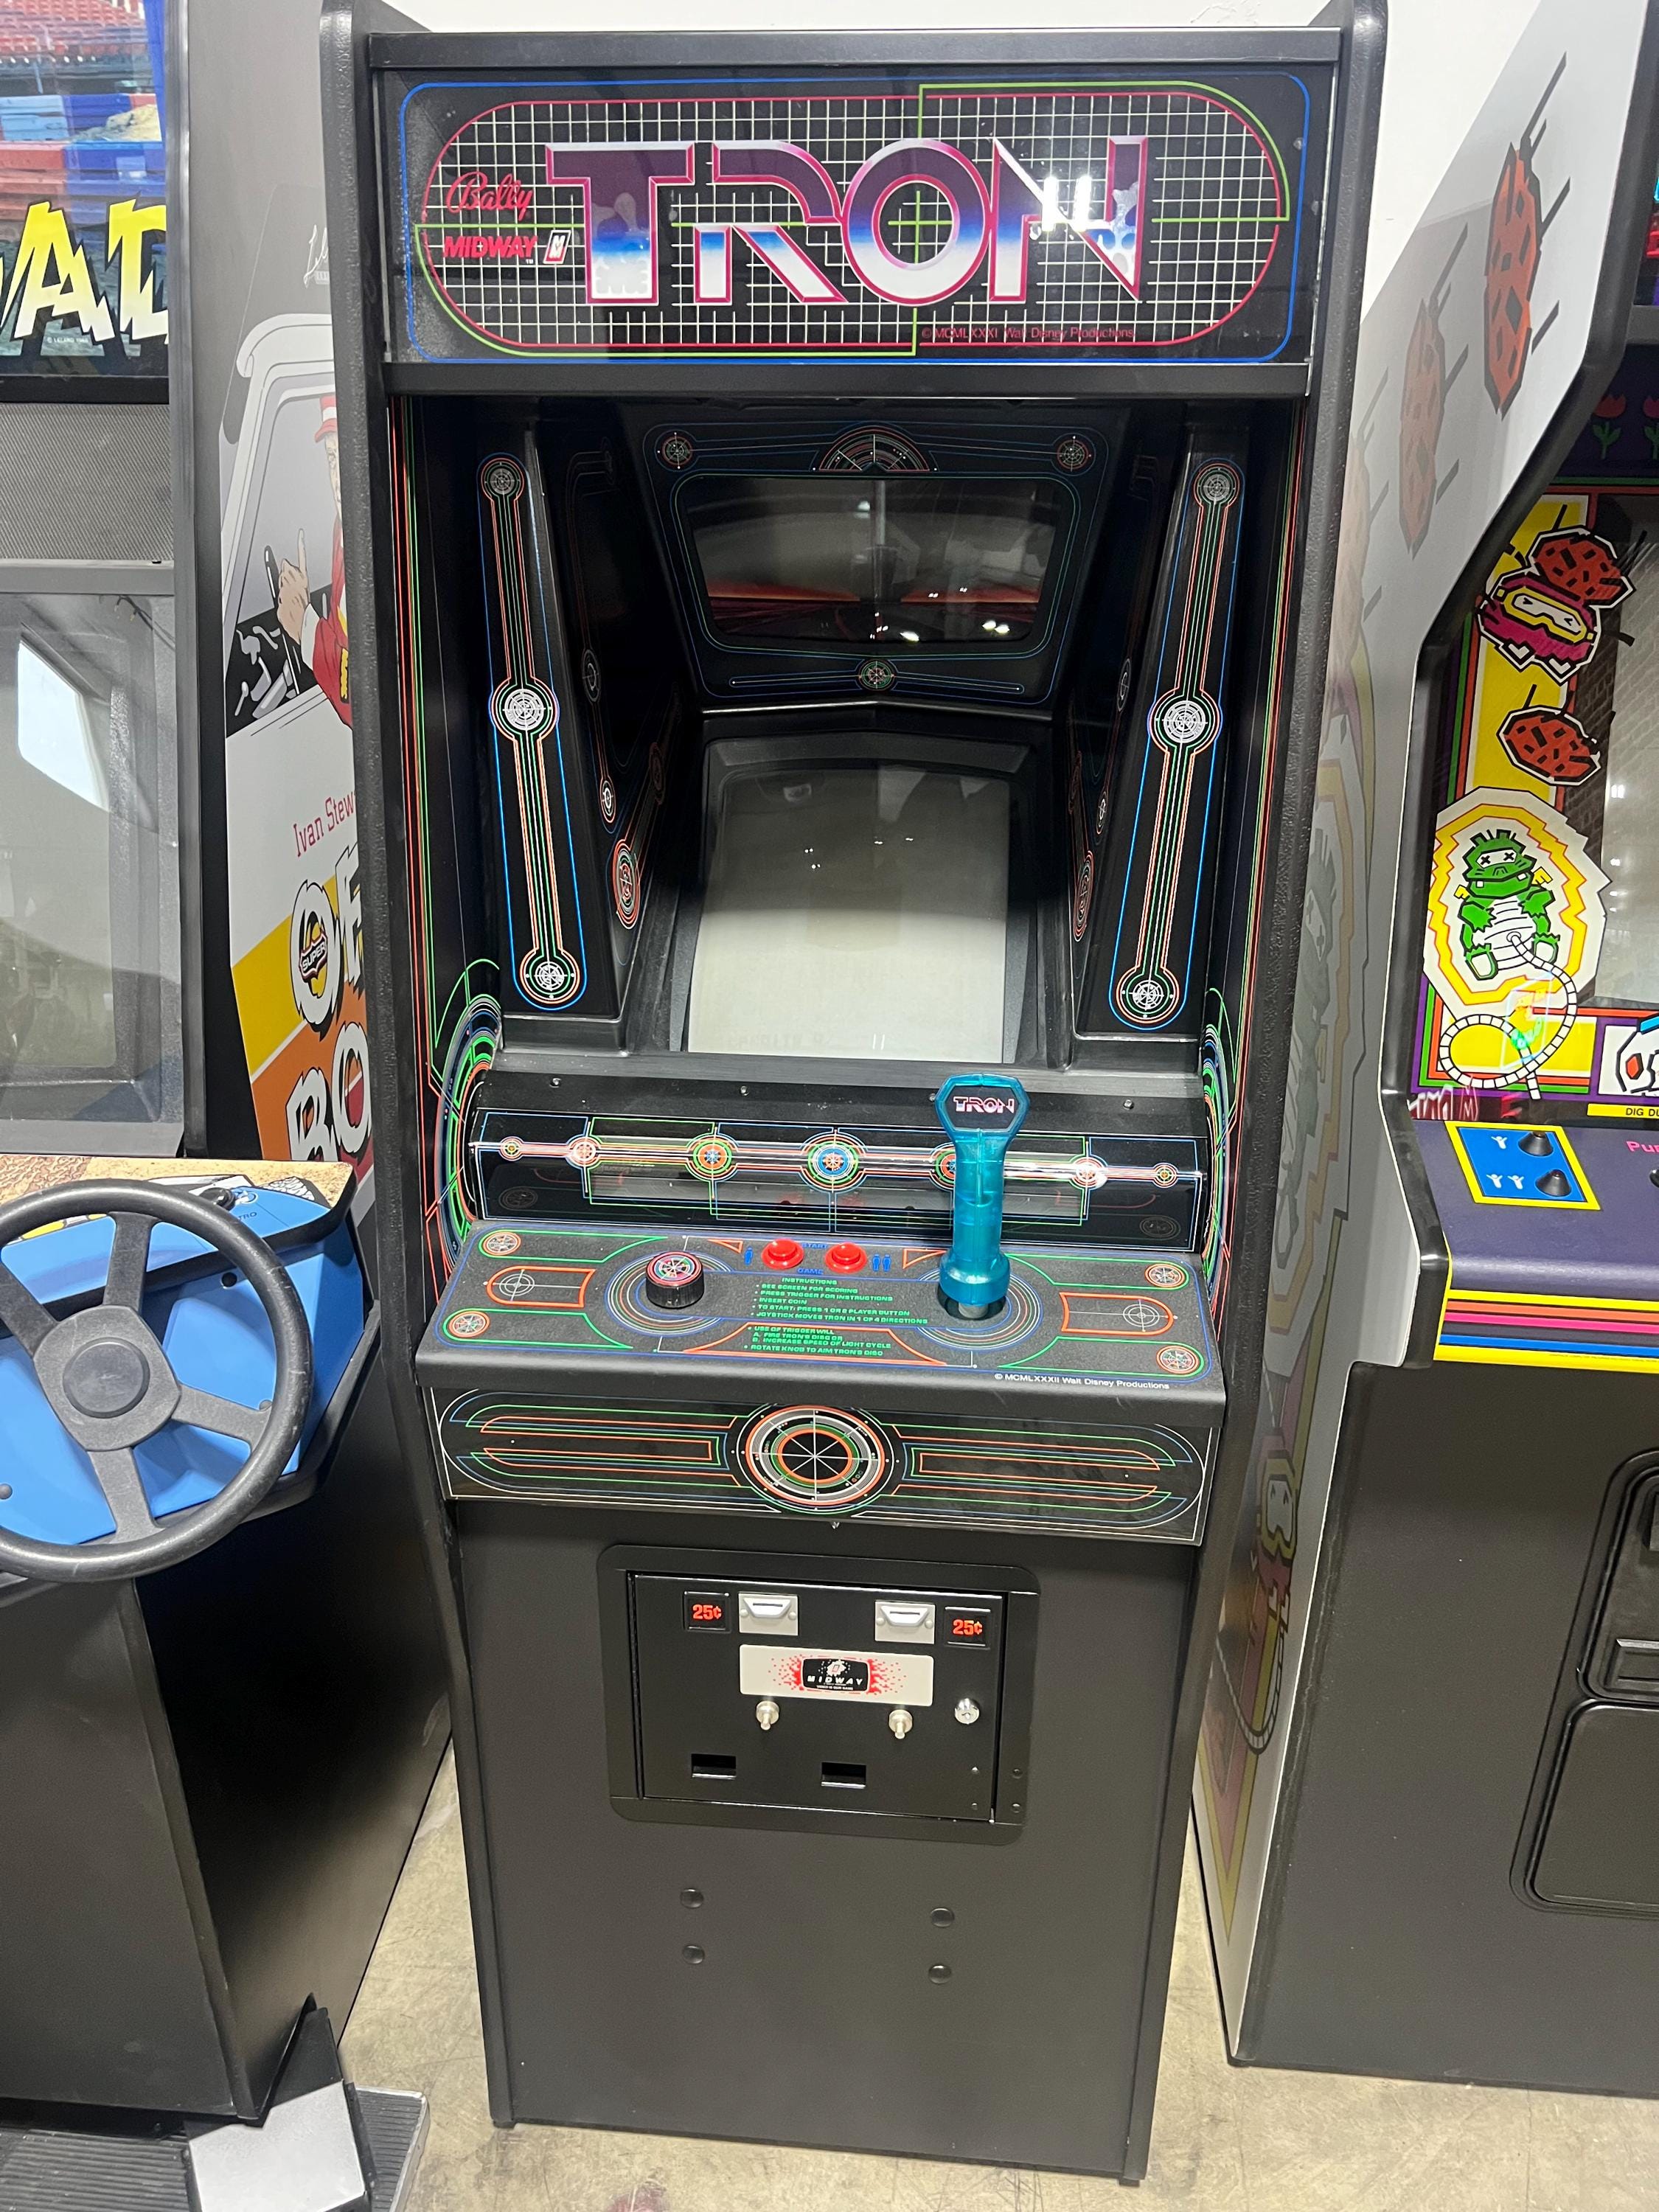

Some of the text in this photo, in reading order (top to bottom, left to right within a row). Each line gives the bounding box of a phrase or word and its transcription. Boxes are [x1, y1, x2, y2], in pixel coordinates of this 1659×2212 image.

[445, 170, 533, 221] Bally
[545, 137, 1150, 306] TRON
[443, 235, 538, 258] MIDWAY
[1031, 327, 1068, 341] Disney
[1070, 326, 1135, 339] Productions
[293, 790, 355, 858] Ivan Stew
[302, 942, 327, 972] SUPER
[953, 1096, 1015, 1114] TRON
[1626, 1107, 1644, 1116] DIG
[782, 1277, 838, 1285] INSTRUCTIONS
[1004, 1373, 1060, 1384] MCMLXXXII
[1062, 1377, 1082, 1385] Walt
[1084, 1378, 1114, 1388] Disney
[1116, 1380, 1169, 1390] Productions
[692, 1604, 722, 1620] 25¢
[953, 1619, 983, 1635] 25¢
[807, 1675, 863, 1686] MIDWAY
